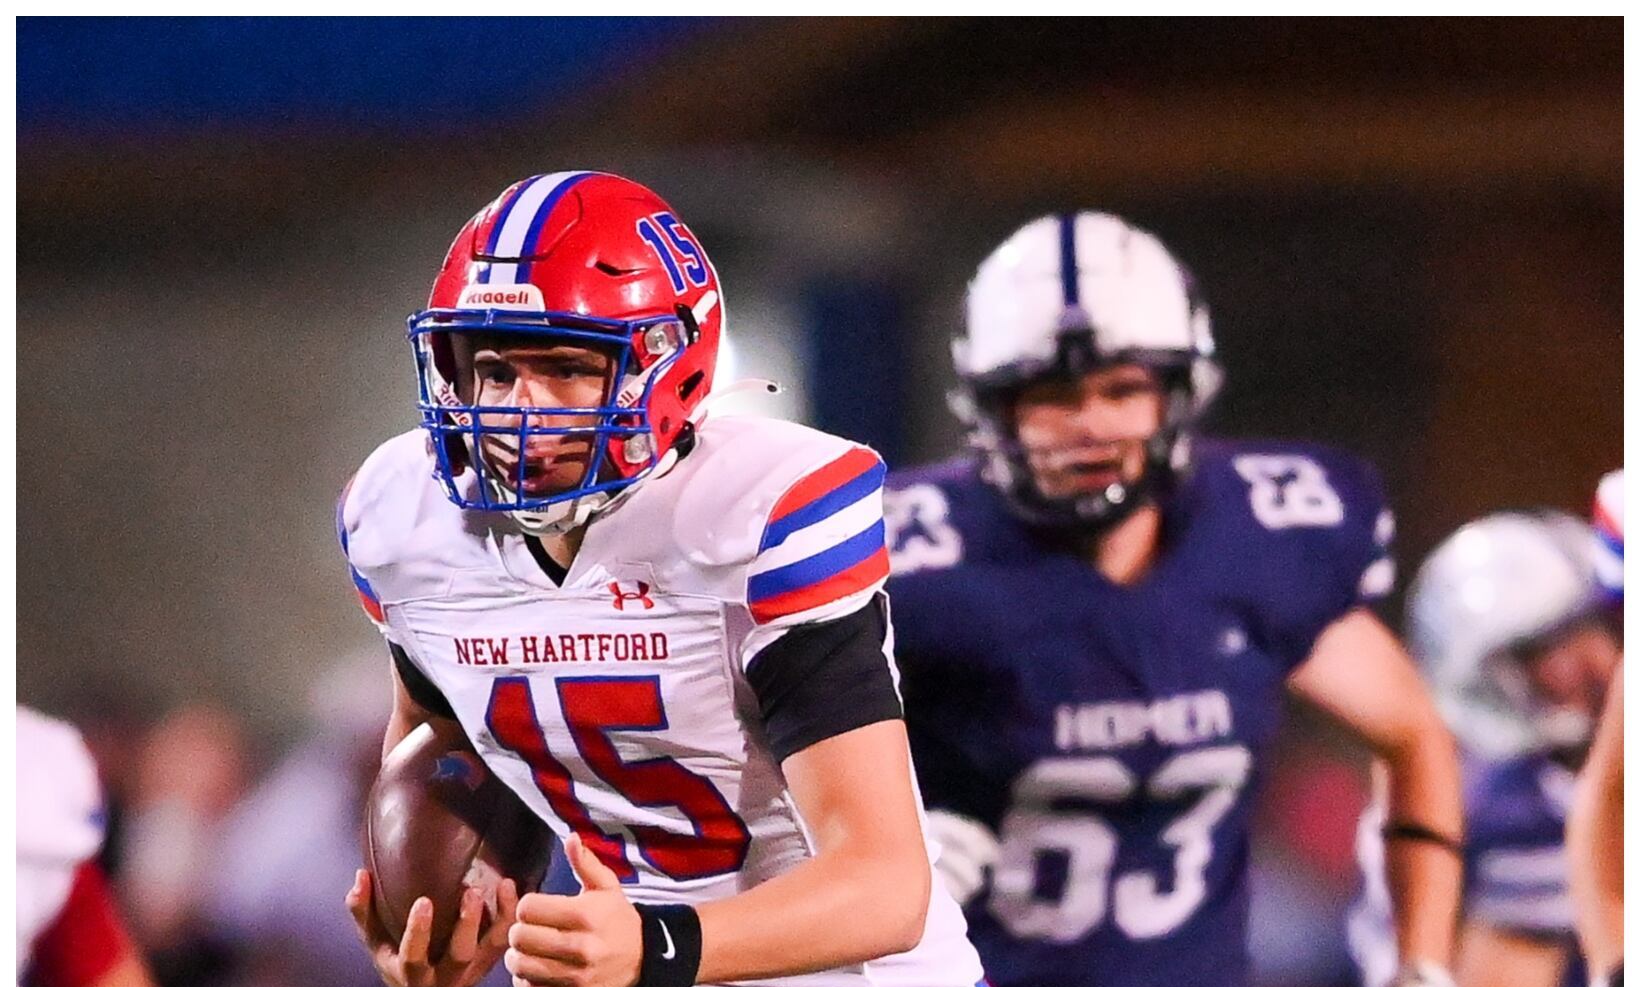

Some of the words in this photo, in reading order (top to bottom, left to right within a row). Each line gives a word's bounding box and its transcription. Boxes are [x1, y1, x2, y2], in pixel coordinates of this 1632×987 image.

[635, 211, 708, 296] 15
[454, 638, 509, 665] NEW
[520, 632, 669, 664] HARTFORD
[484, 674, 752, 885] 15
[988, 746, 1250, 943] 63
